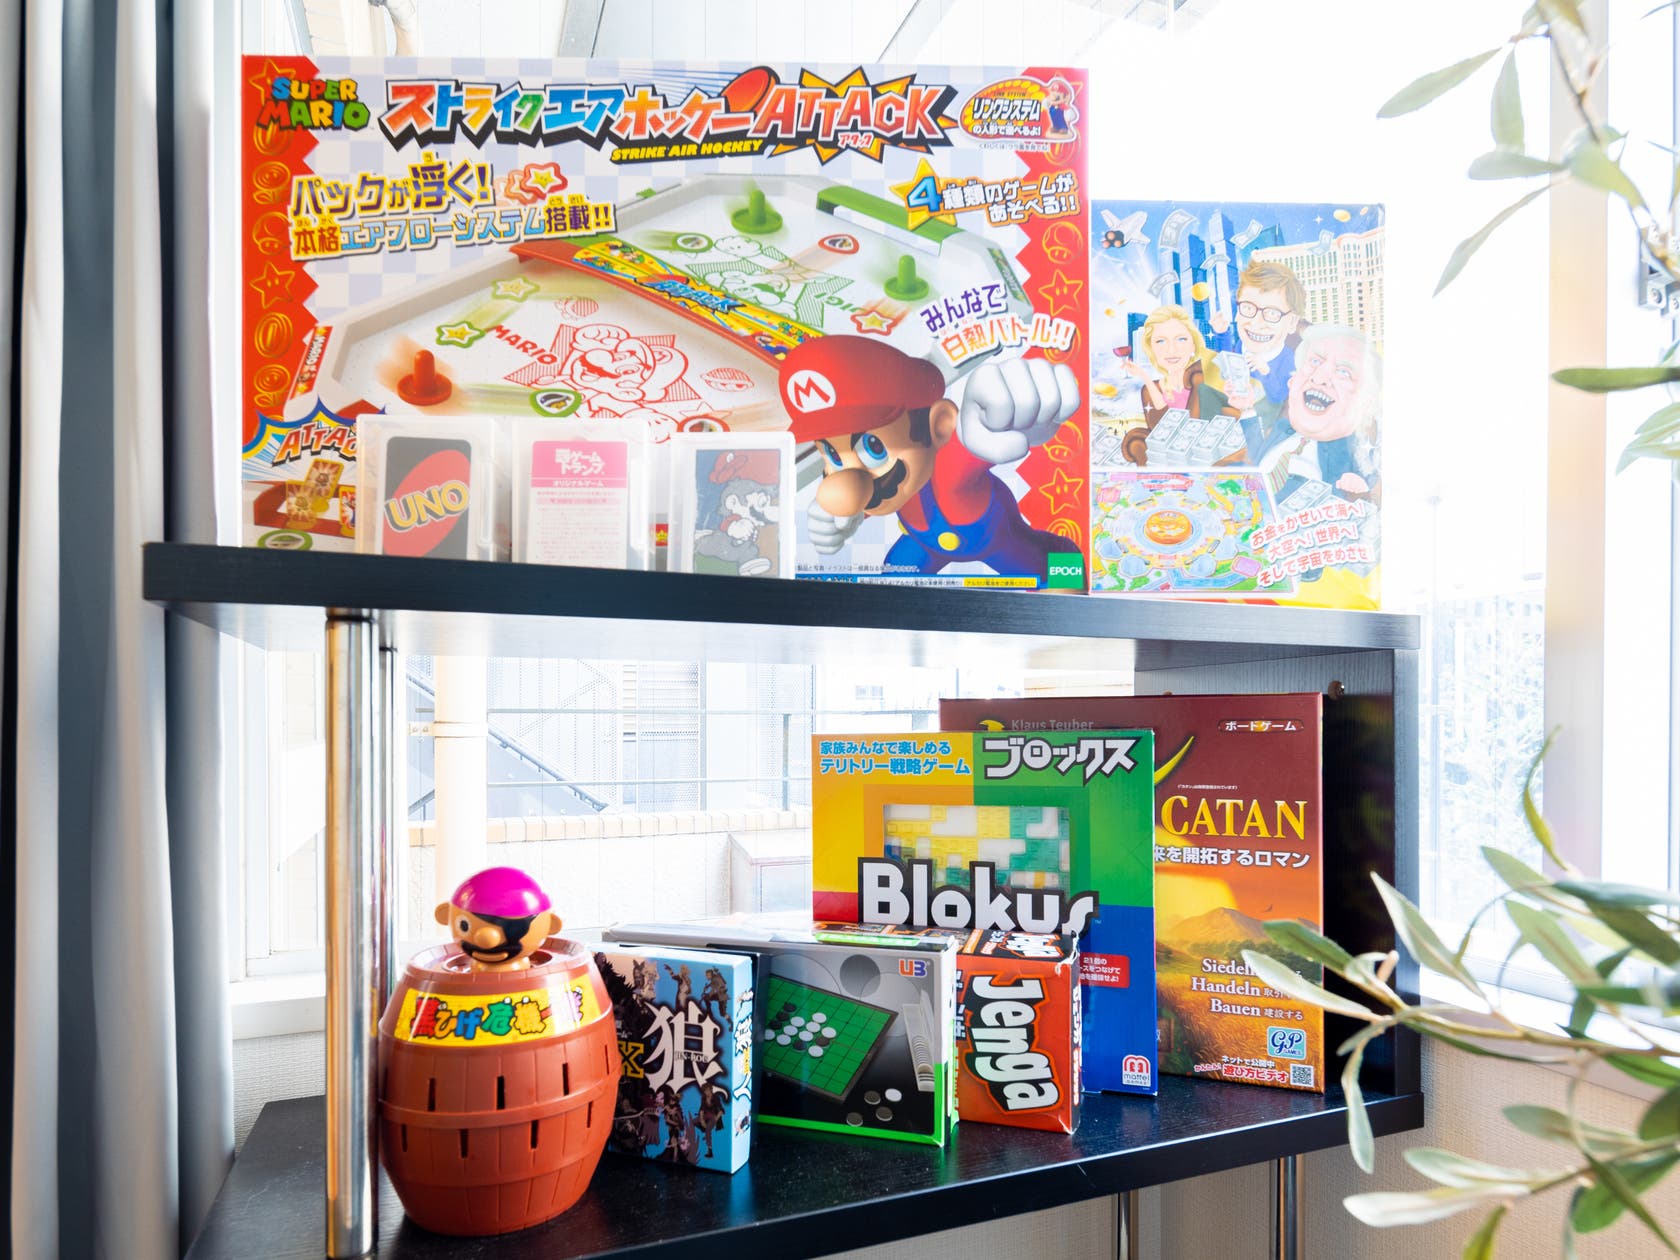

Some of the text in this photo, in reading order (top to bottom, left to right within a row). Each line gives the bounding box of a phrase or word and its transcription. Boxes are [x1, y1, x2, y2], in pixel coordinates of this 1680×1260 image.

[272, 77, 358, 100] SUPER
[258, 99, 370, 131] MARIO
[749, 85, 948, 141] ATTACK
[973, 98, 1041, 120] リンクシステム
[611, 139, 763, 161] STRIKE AIR HOCKEY
[920, 283, 1003, 333] みんなで
[495, 324, 558, 365] MARIO
[384, 480, 469, 532] UNO
[1049, 566, 1082, 576] EPOCH
[1011, 719, 1095, 730] Klaus Teuber
[1225, 720, 1297, 732] ボードゲーム
[820, 741, 951, 755] 家族みんなで楽しめる
[820, 758, 971, 775] テリトリー戦略ゲーム
[983, 736, 1140, 785] ブロックス
[1160, 795, 1309, 840] CATAN
[860, 858, 1096, 935] Blokus
[1202, 958, 1257, 977] Siedel
[1191, 976, 1261, 996] Handeln
[1210, 998, 1261, 1016] Bauen
[1263, 1008, 1304, 1021] 建設する
[971, 976, 1061, 1111] Jenga
[1271, 1030, 1303, 1054] GP
[1223, 1064, 1289, 1083] 遊び方ビデオ
